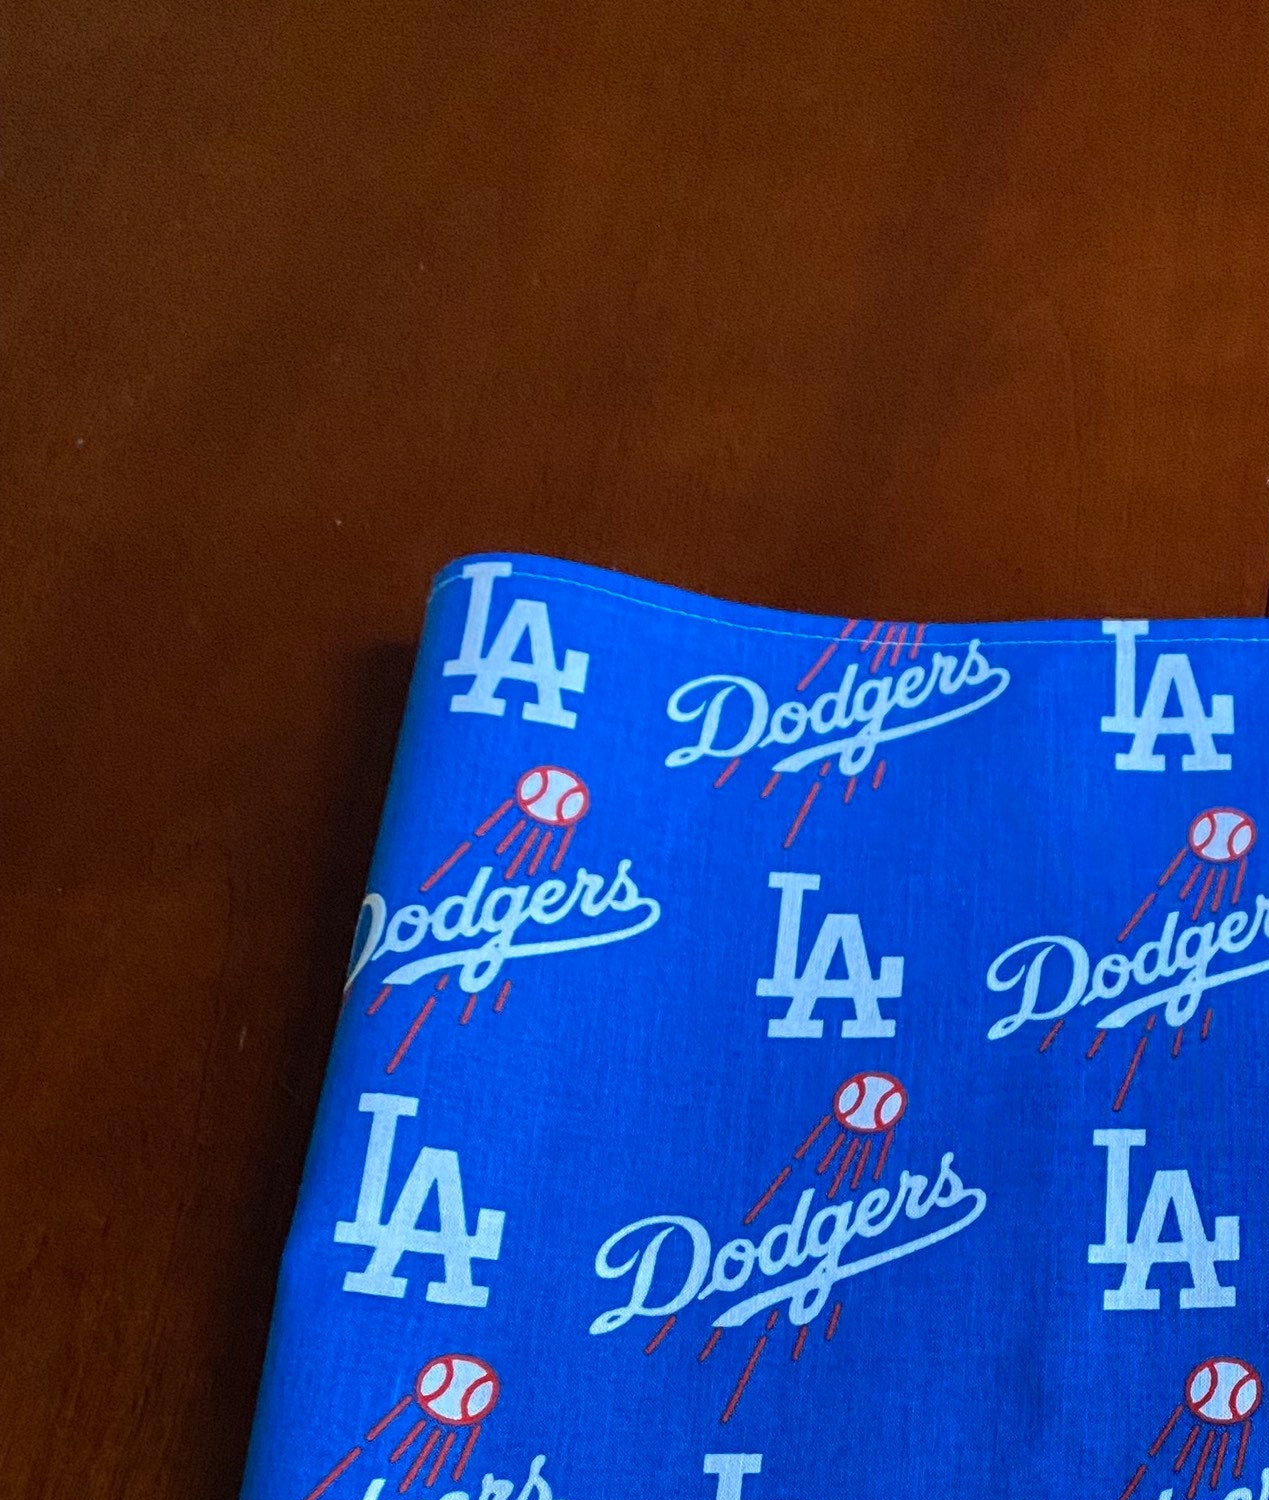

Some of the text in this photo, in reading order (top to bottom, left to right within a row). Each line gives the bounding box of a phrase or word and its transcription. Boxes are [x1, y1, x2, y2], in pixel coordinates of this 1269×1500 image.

[443, 561, 589, 729] LA
[664, 638, 1010, 776] Dodgers
[1101, 620, 1234, 771] LA
[755, 872, 904, 1039] LA
[334, 1093, 505, 1307] LA
[589, 1151, 987, 1335] Dodgers
[1087, 1129, 1241, 1310] LA
